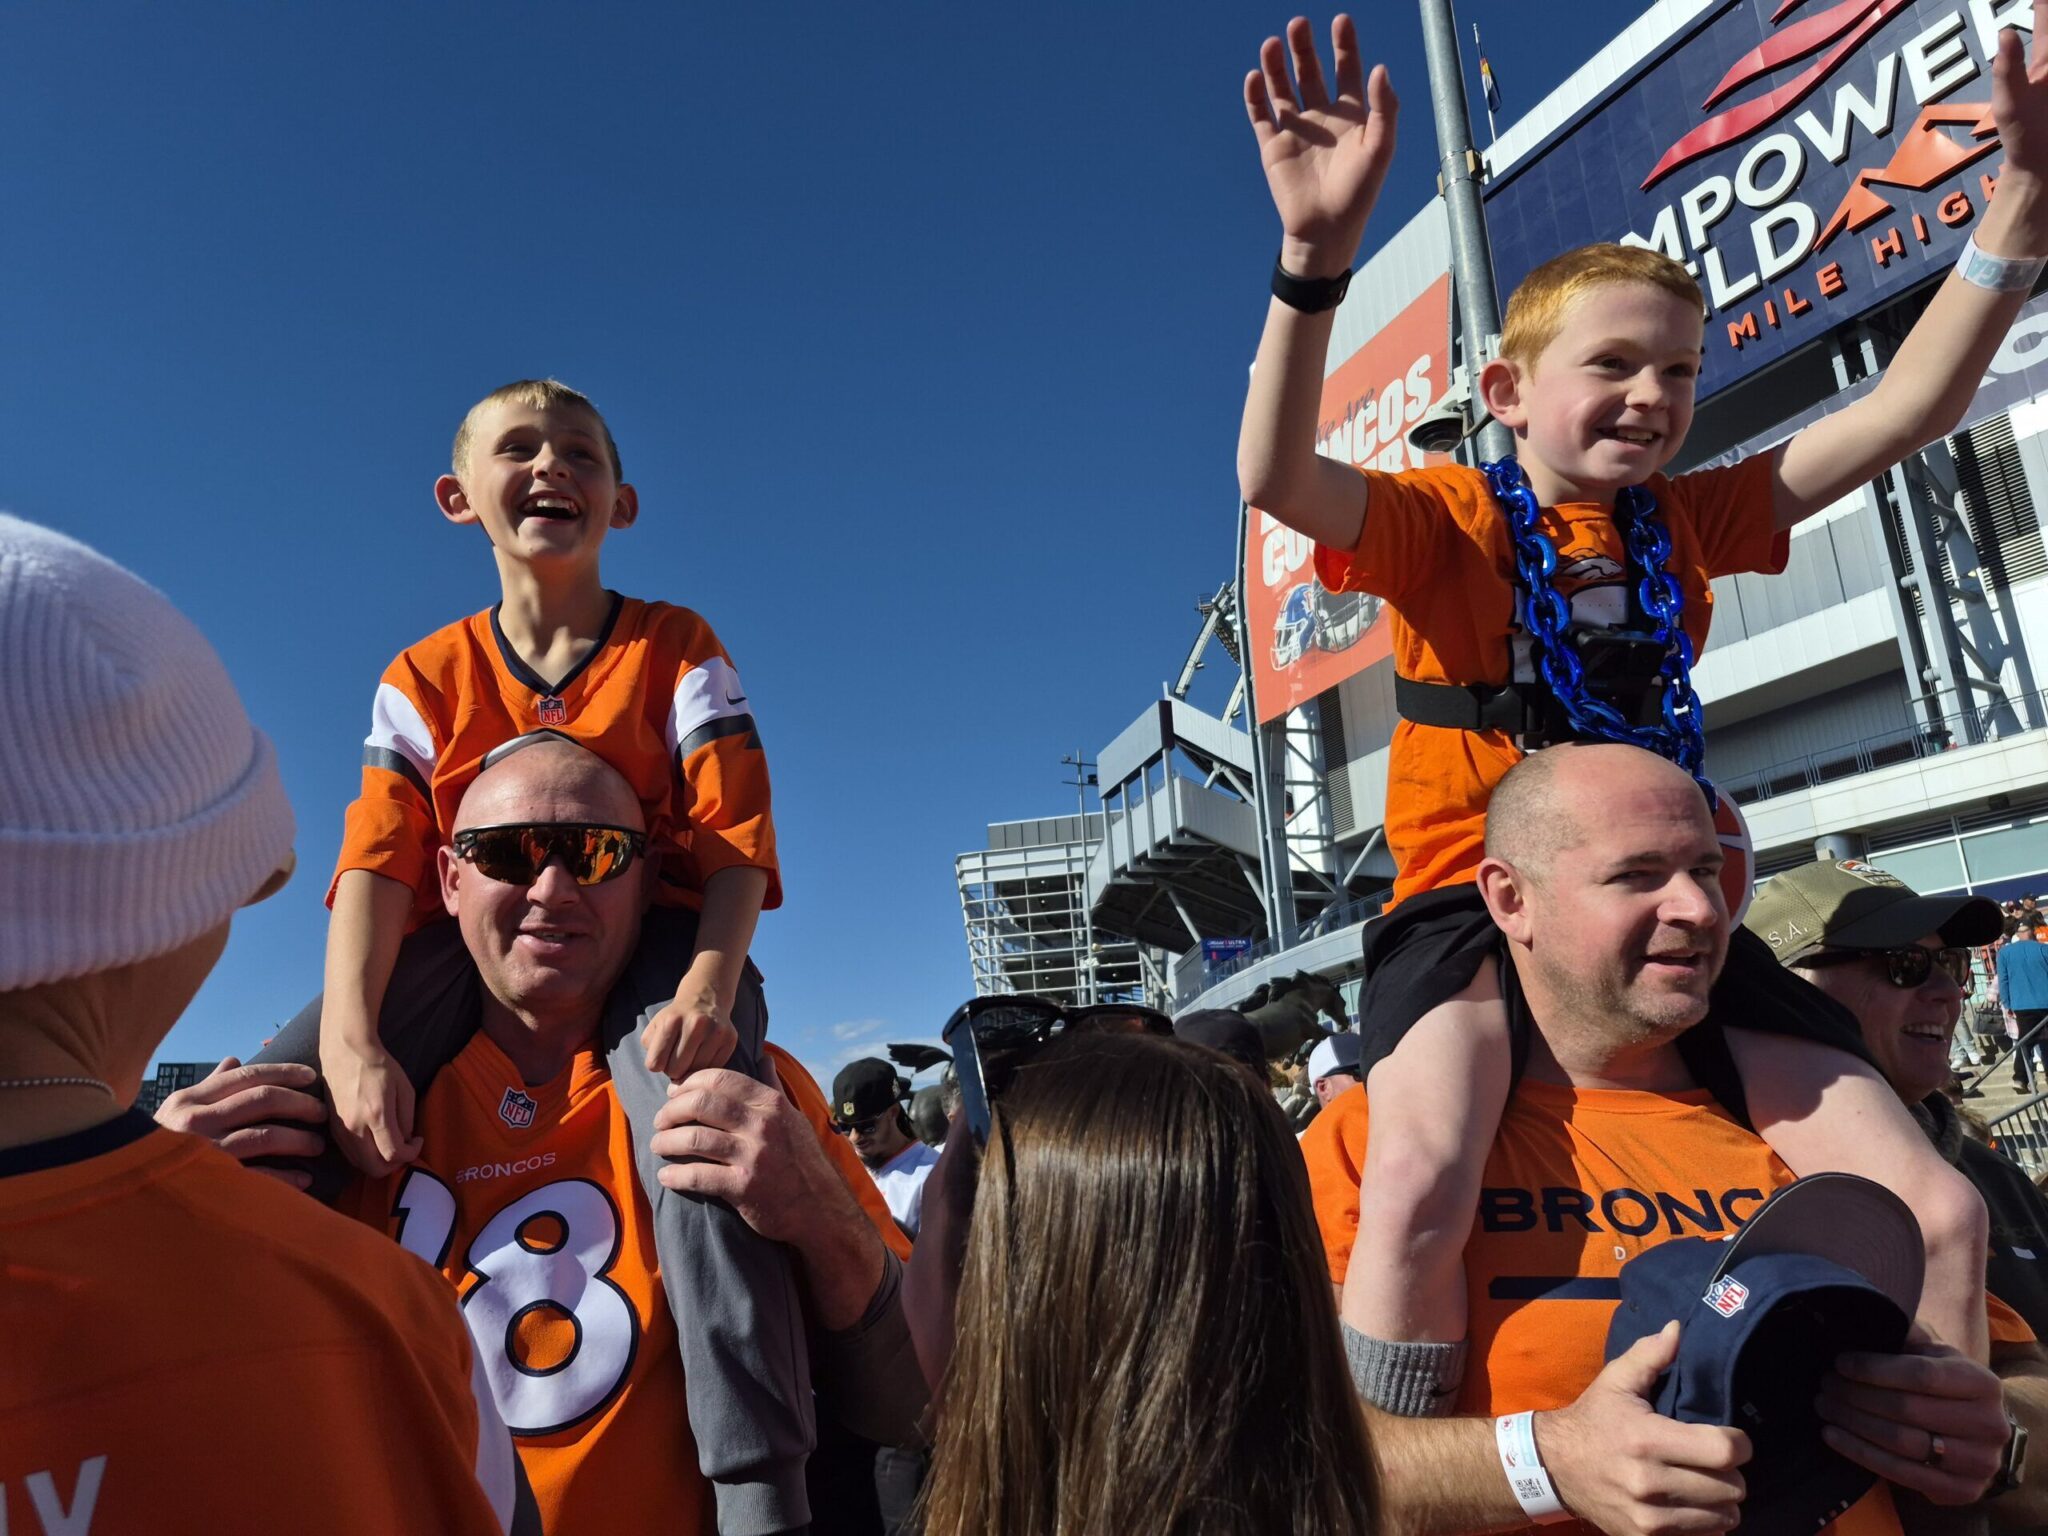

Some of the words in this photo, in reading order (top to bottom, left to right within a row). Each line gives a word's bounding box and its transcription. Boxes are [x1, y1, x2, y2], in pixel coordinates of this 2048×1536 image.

[1727, 262, 1844, 348] MILE
[543, 709, 563, 723] NFL
[1768, 921, 1808, 948] S.A.
[504, 1102, 529, 1122] NFL
[1480, 1187, 1765, 1237] BRONC
[1717, 1287, 1745, 1313] NFL
